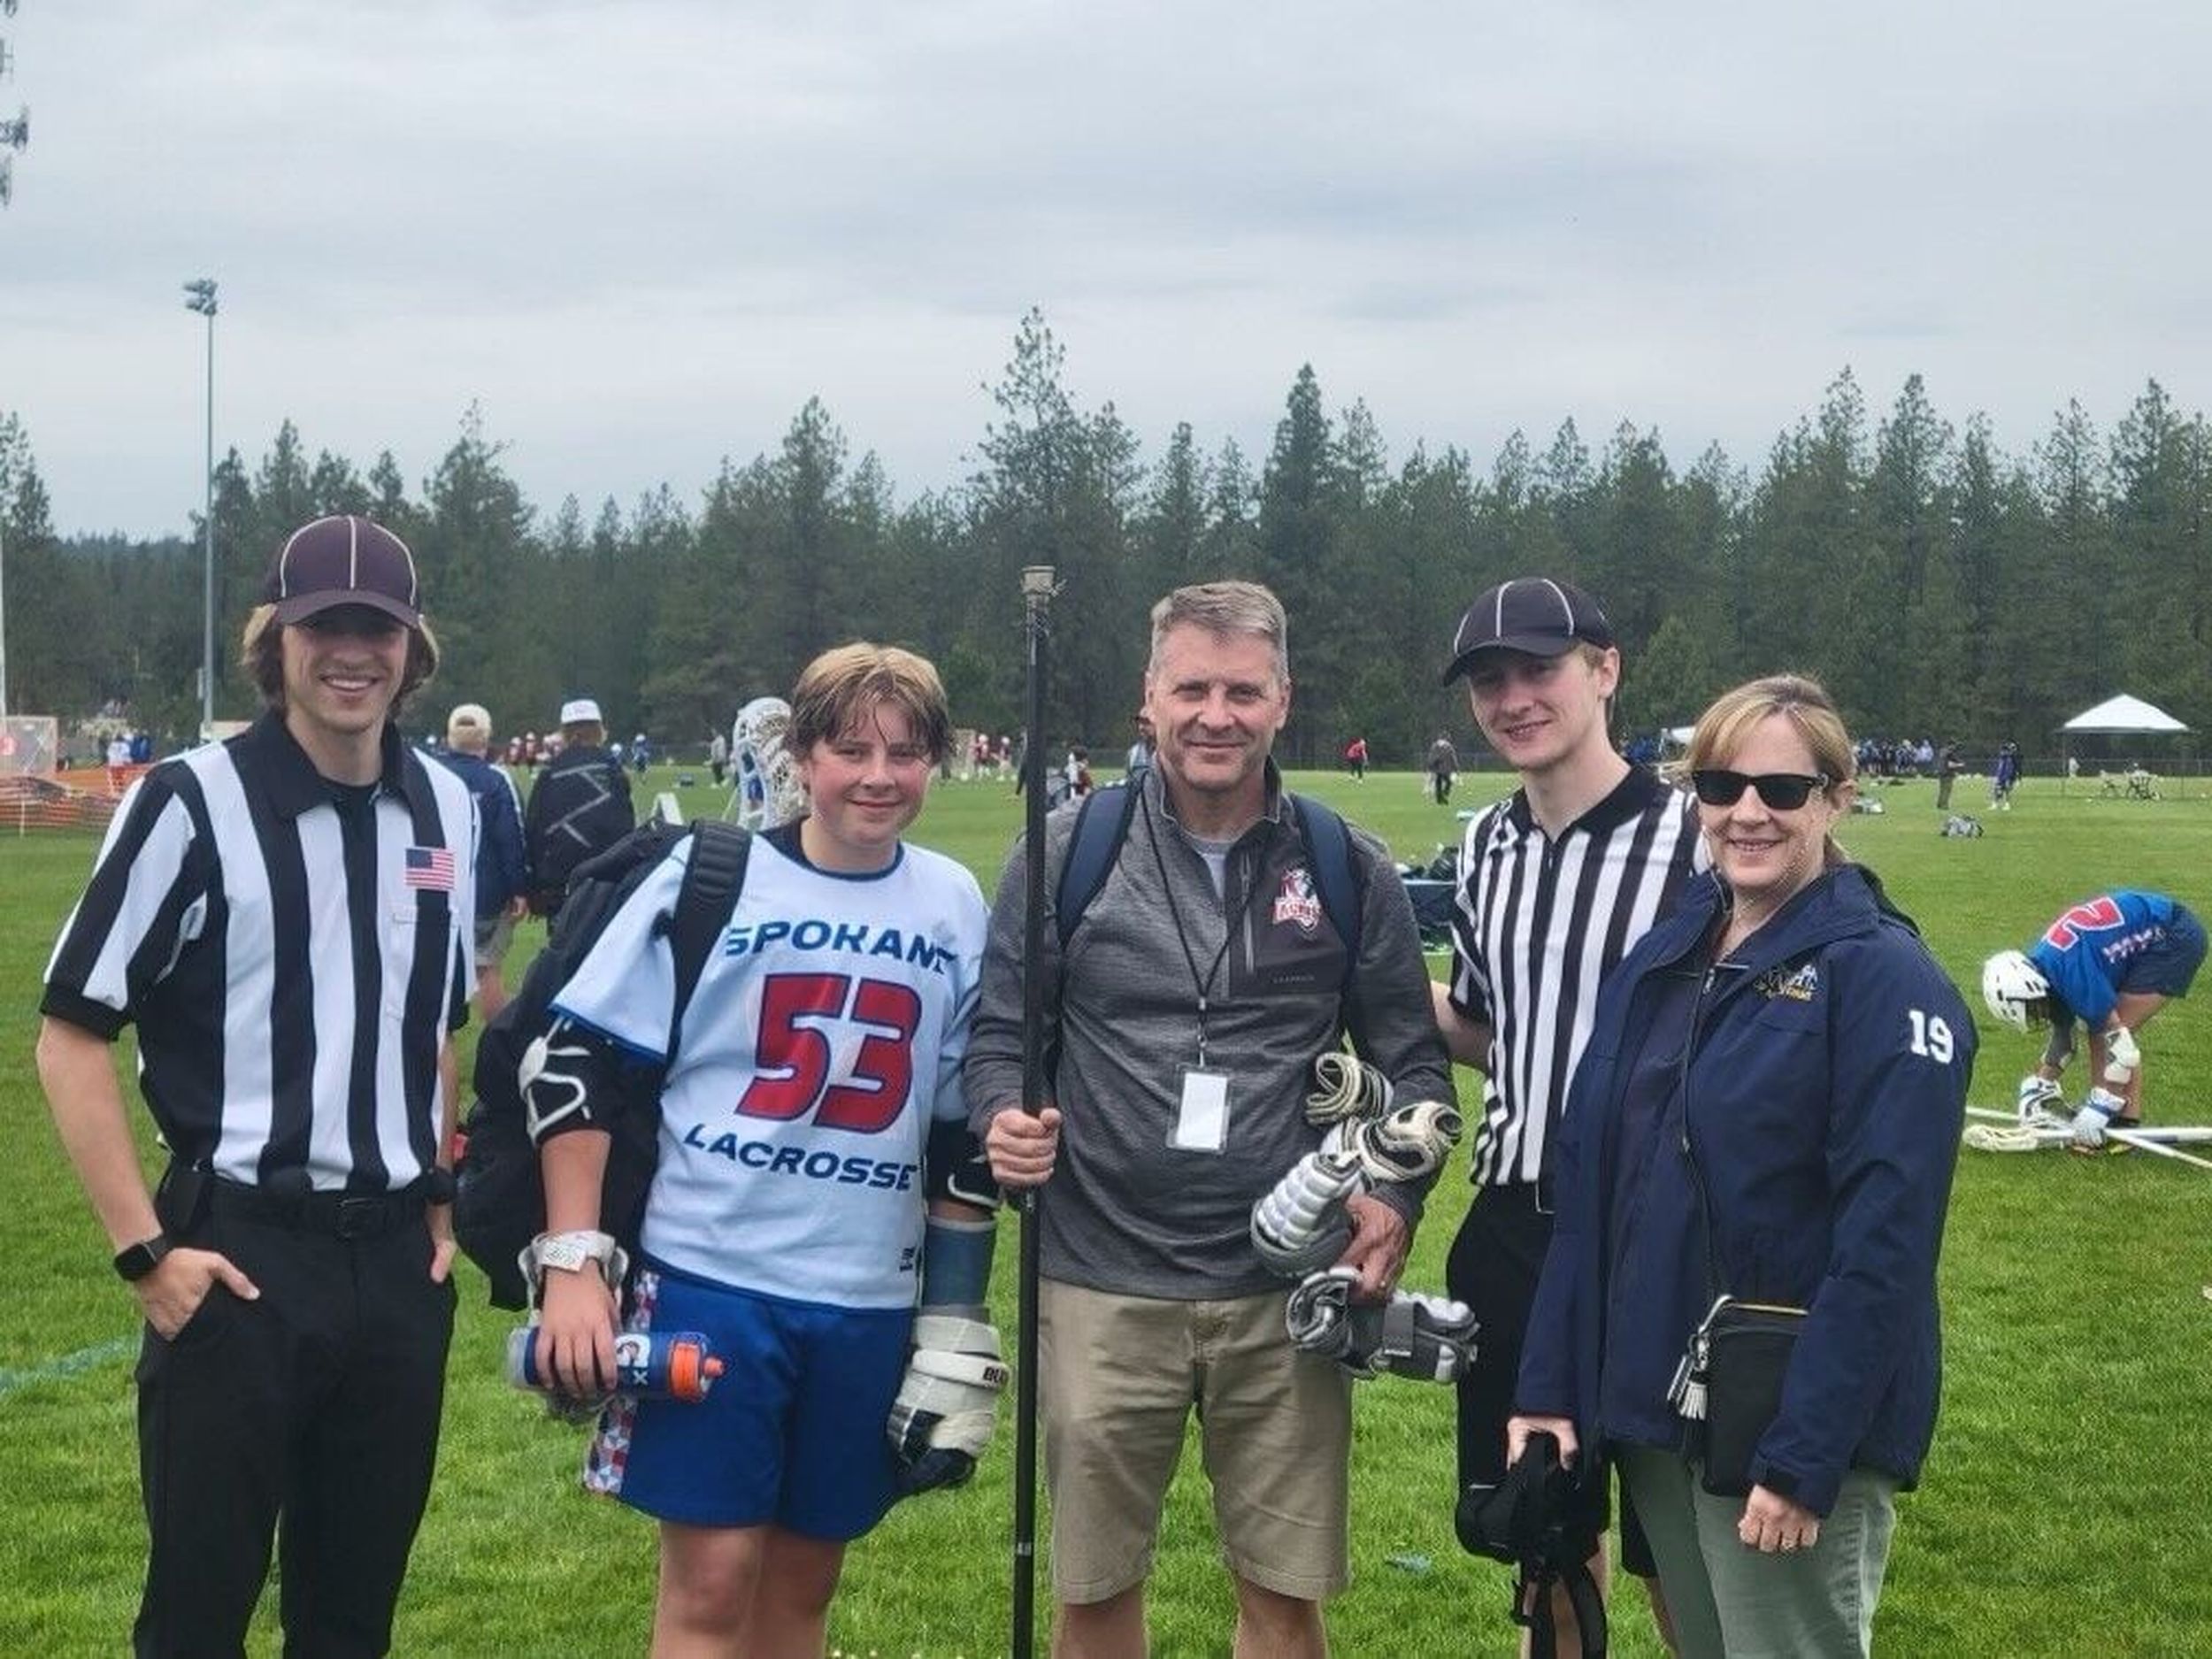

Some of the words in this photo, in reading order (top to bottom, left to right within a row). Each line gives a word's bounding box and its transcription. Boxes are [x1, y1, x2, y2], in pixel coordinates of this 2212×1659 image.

[734, 972, 922, 1134] 53
[1909, 1009, 1954, 1064] 19
[683, 1123, 918, 1192] LACROSSE
